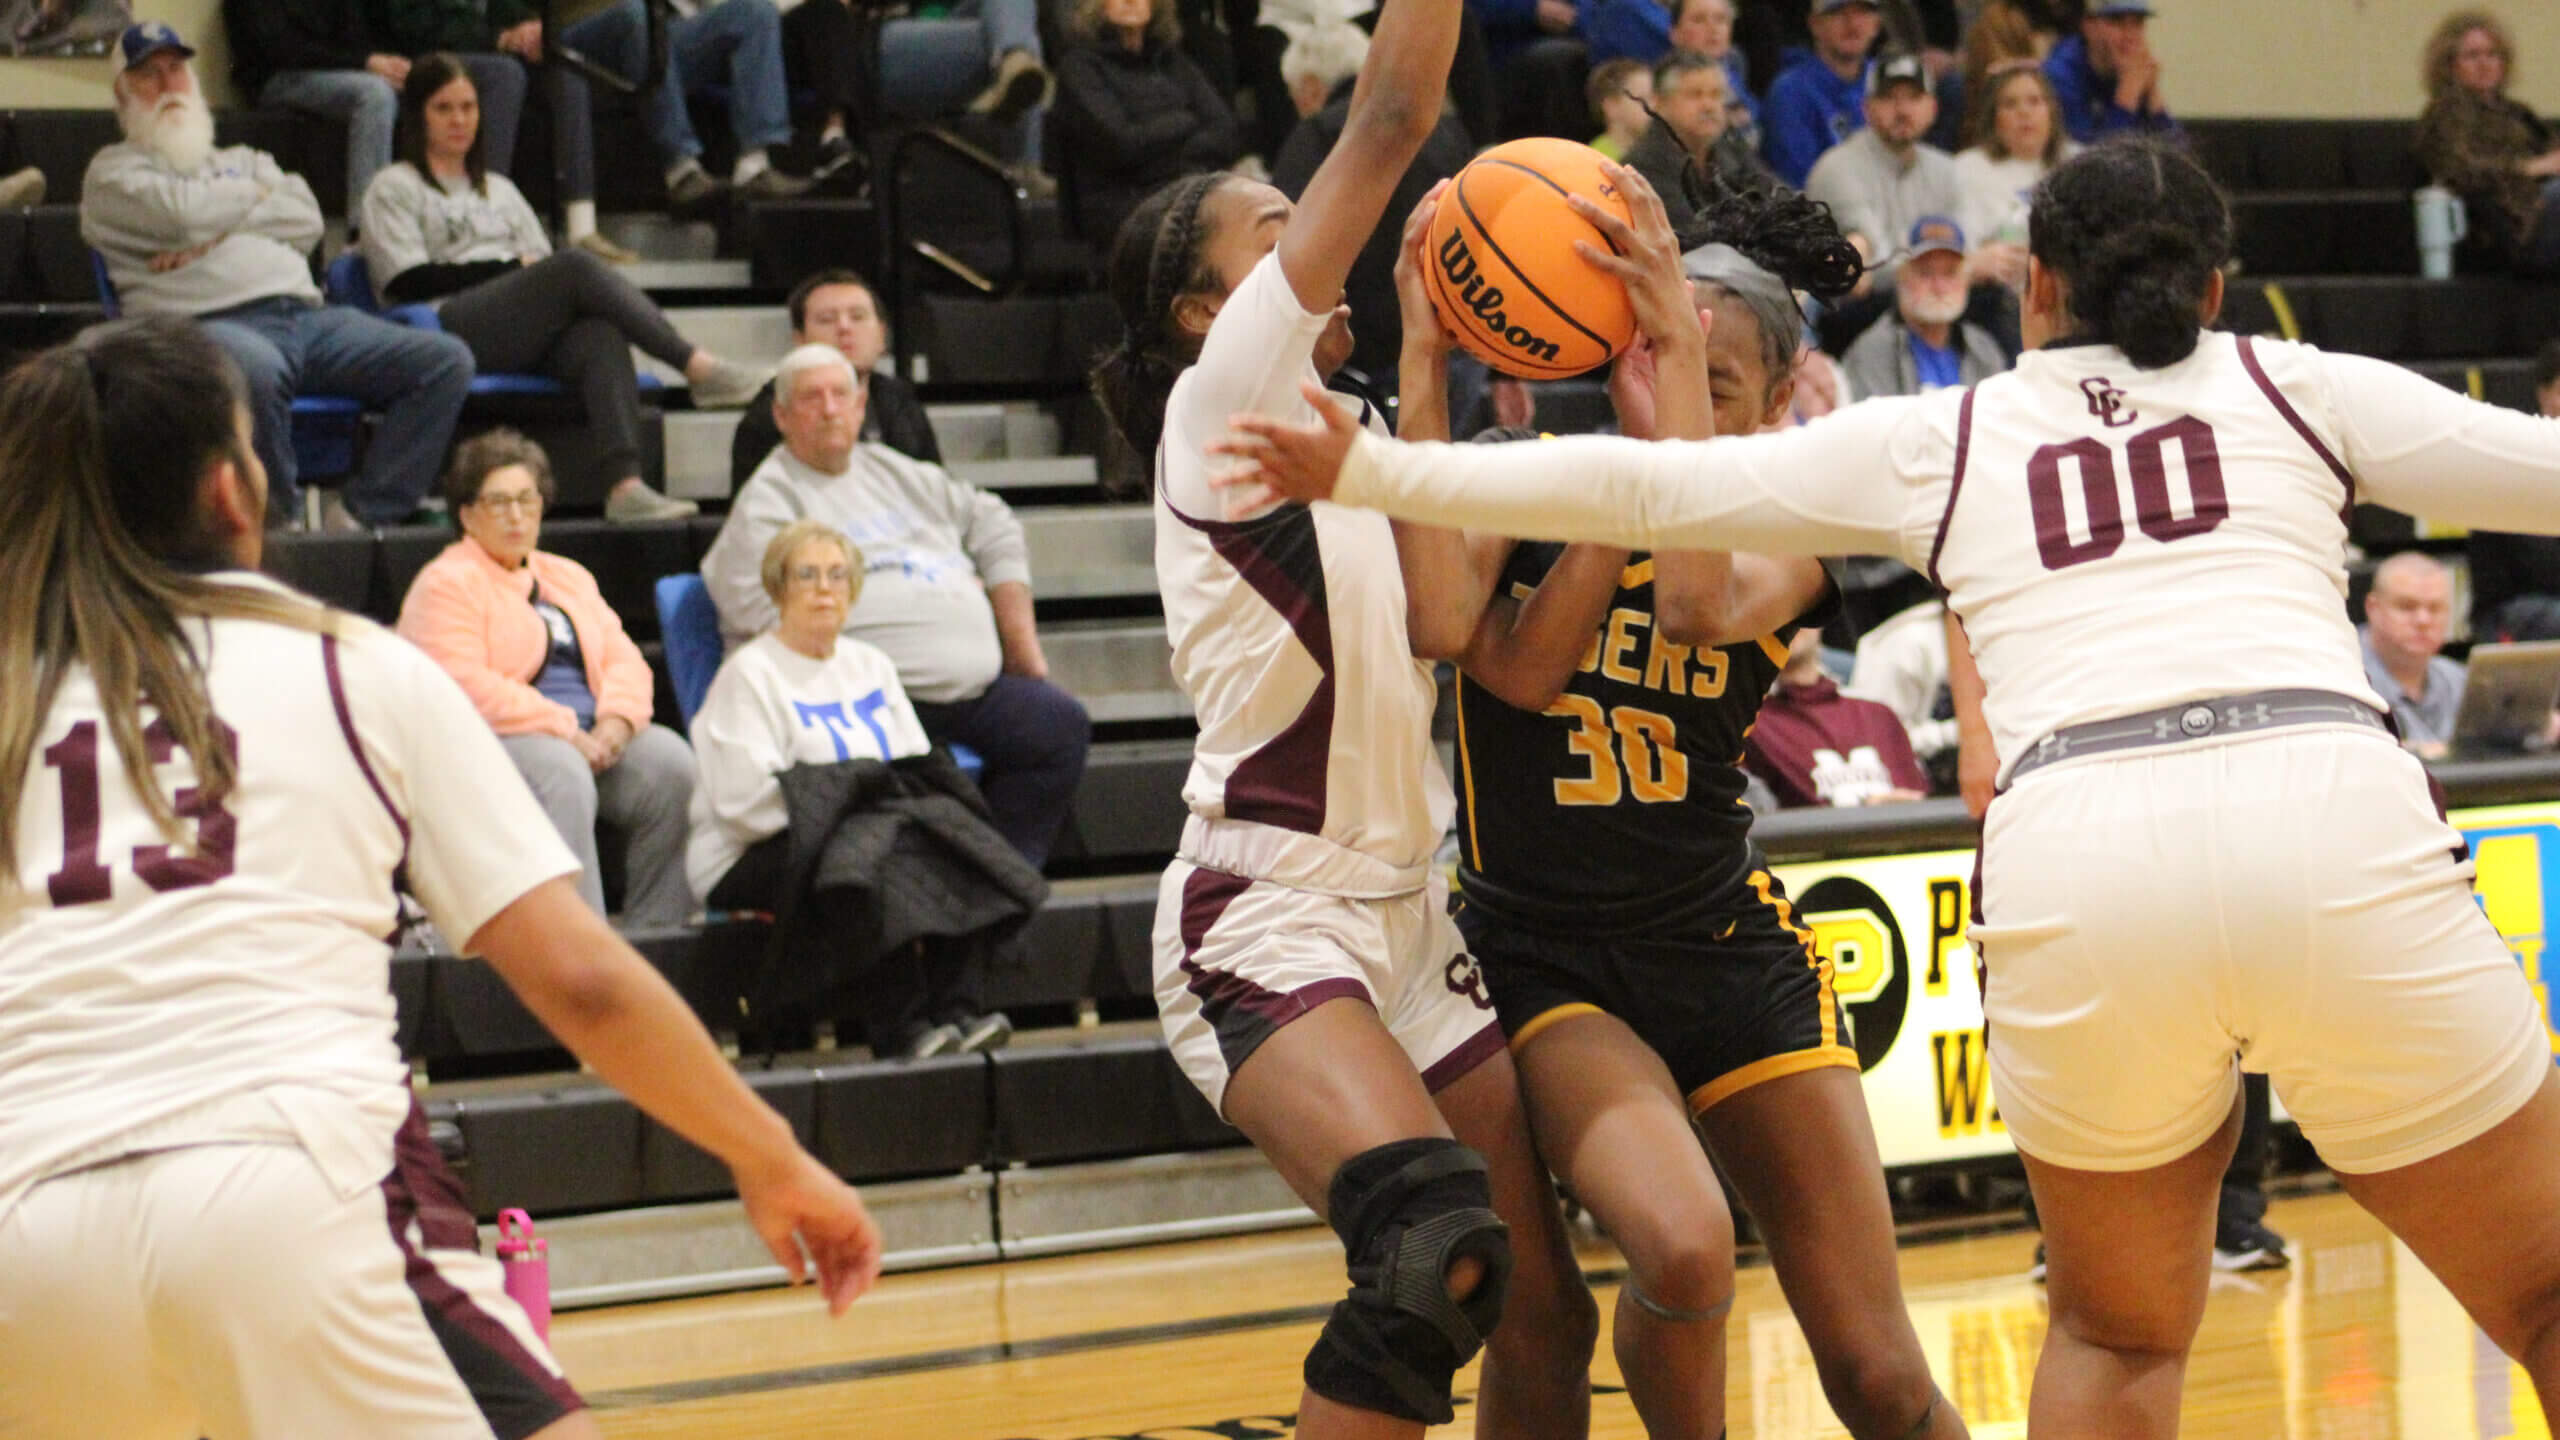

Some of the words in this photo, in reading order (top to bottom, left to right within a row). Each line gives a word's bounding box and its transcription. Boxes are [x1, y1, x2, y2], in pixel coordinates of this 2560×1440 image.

[1440, 226, 1560, 362] Wilson
[2026, 413, 2230, 571] 00
[1511, 581, 1729, 699] ERS
[44, 714, 240, 909] 13
[1541, 693, 1688, 806] 30
[1927, 881, 1978, 984] P
